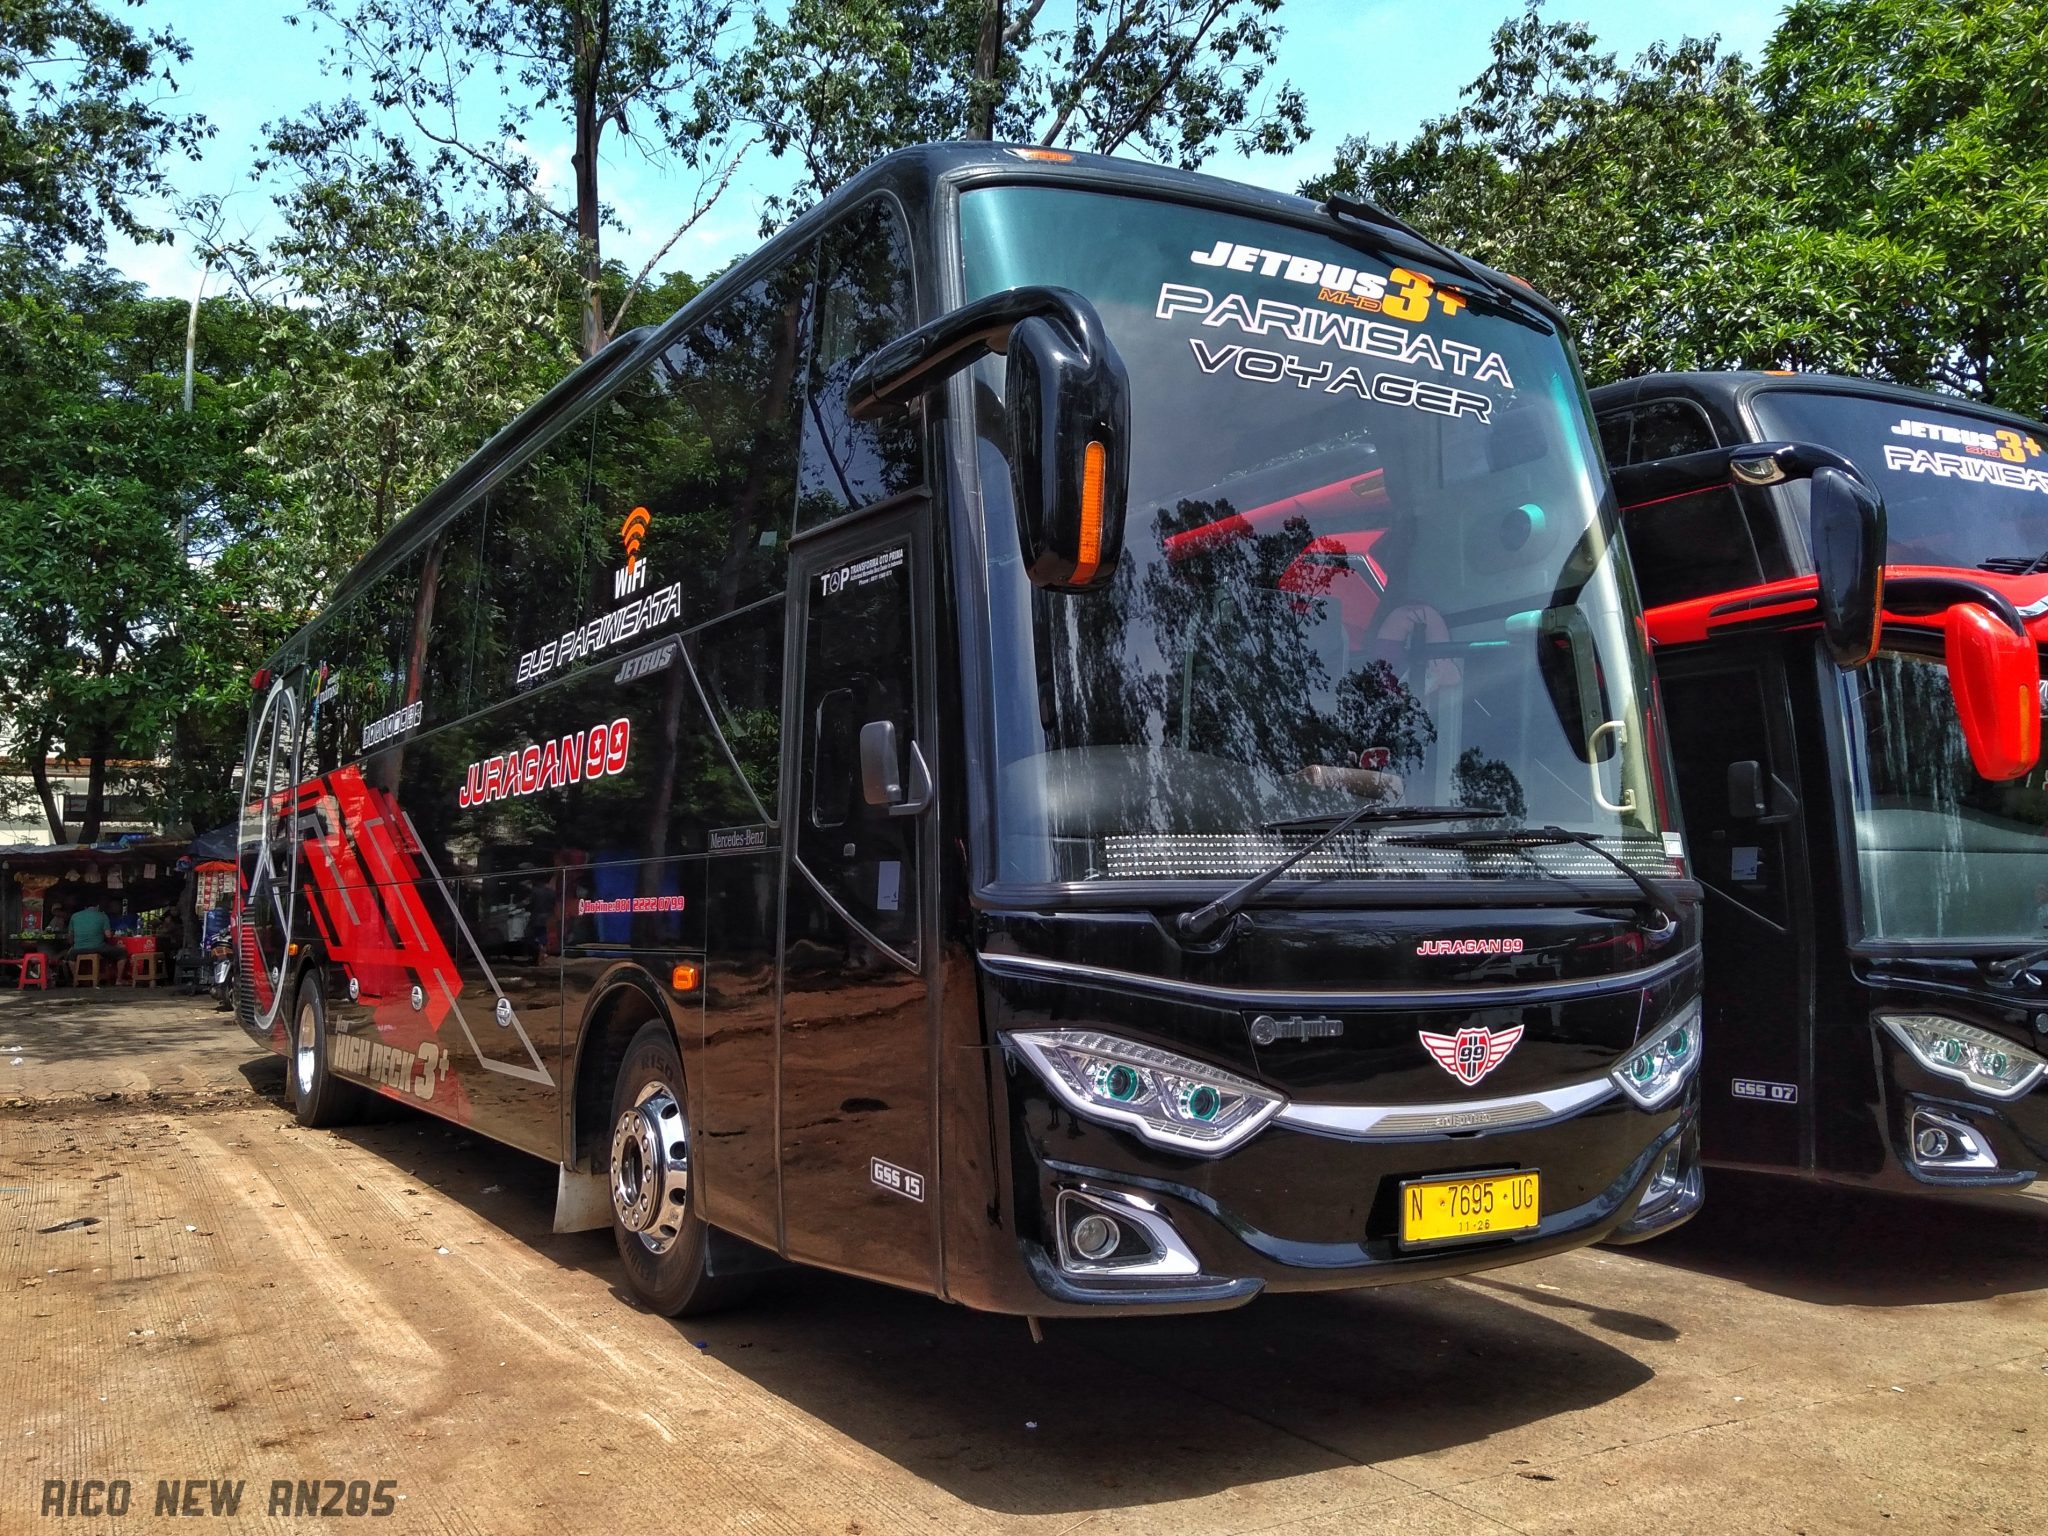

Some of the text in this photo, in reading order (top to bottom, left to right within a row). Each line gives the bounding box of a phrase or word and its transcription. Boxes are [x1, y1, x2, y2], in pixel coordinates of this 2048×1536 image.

[1190, 240, 1388, 300] JETBUS
[1317, 287, 1382, 314] MHD
[1155, 282, 1514, 389] PARIWISATA
[1189, 338, 1492, 425] VOYAGER
[1891, 419, 1998, 450] JETBUS
[614, 556, 648, 600] WiFi
[516, 581, 681, 684] BUS PARIWISATA
[614, 643, 674, 684] JETBUS
[459, 717, 630, 808] JURAGAN 99
[710, 829, 765, 849] Mercedes-Benz
[657, 895, 685, 911] 0799
[1416, 938, 1523, 956] JURAGAN 99
[334, 1032, 371, 1077] HIGH
[369, 1042, 416, 1093] DECK
[1458, 1044, 1485, 1062] 99
[1734, 1081, 1794, 1100] GSS 07
[874, 1162, 920, 1196] GSS 15
[1411, 1178, 1533, 1221] N 7695 UG
